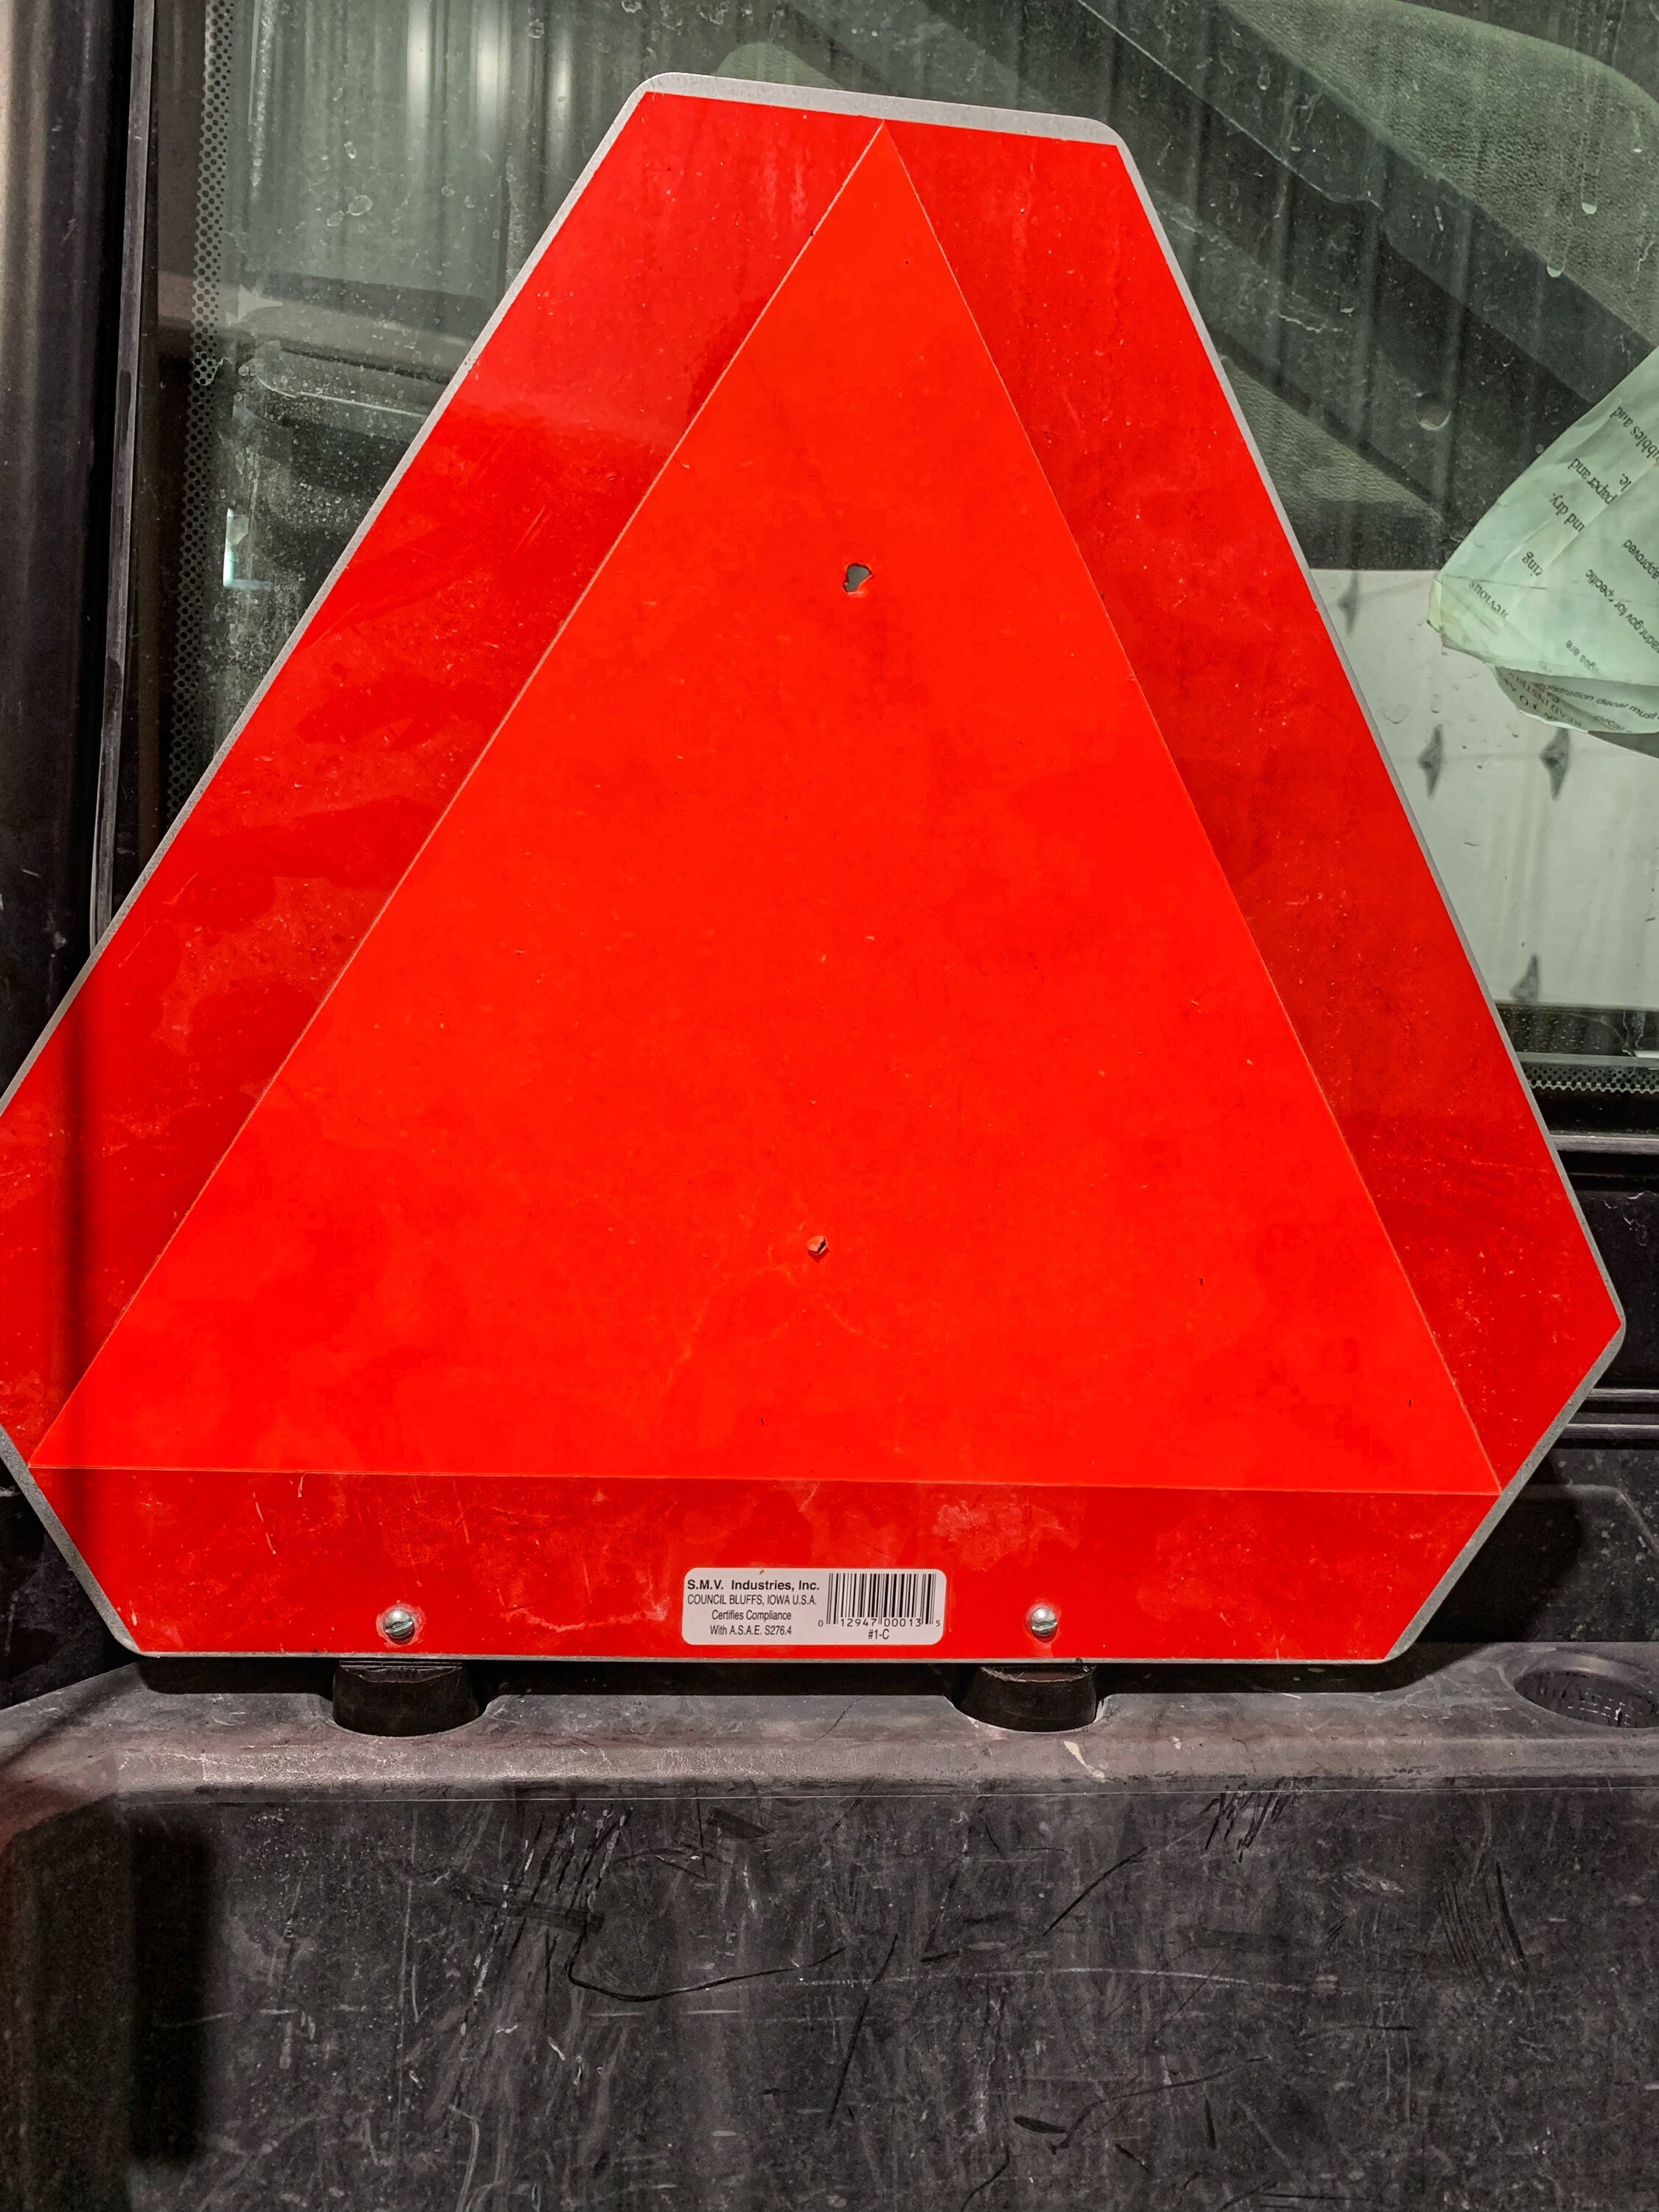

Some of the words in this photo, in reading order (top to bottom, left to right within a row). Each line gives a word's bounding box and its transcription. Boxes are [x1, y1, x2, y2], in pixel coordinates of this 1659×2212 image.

[1630, 425, 1659, 462] ubbles
[1568, 458, 1591, 479] and
[1587, 476, 1618, 505] paper
[1549, 493, 1568, 516] dry.
[1522, 551, 1543, 577] zing
[1621, 539, 1659, 580] approved
[1614, 602, 1627, 616] for
[1565, 640, 1580, 656] are
[1579, 655, 1599, 674] ges
[687, 1579, 724, 1590] S.M.V.
[731, 1579, 794, 1592] Industries,
[799, 1580, 820, 1590] Inc.
[687, 1594, 726, 1605] COUNCIL
[729, 1594, 765, 1606] BLUFFS,
[767, 1594, 790, 1605] IOWA
[792, 1594, 817, 1605] U.S.A.
[712, 1610, 744, 1620] Certifies
[746, 1610, 792, 1622] Compliance
[818, 1619, 824, 1627] 0
[841, 1618, 877, 1627] 12947
[884, 1618, 922, 1627] 00013
[709, 1624, 728, 1635] With
[729, 1625, 762, 1635] A.S.A.E.
[764, 1625, 792, 1635] S276.4
[868, 1628, 890, 1640] #1-C
